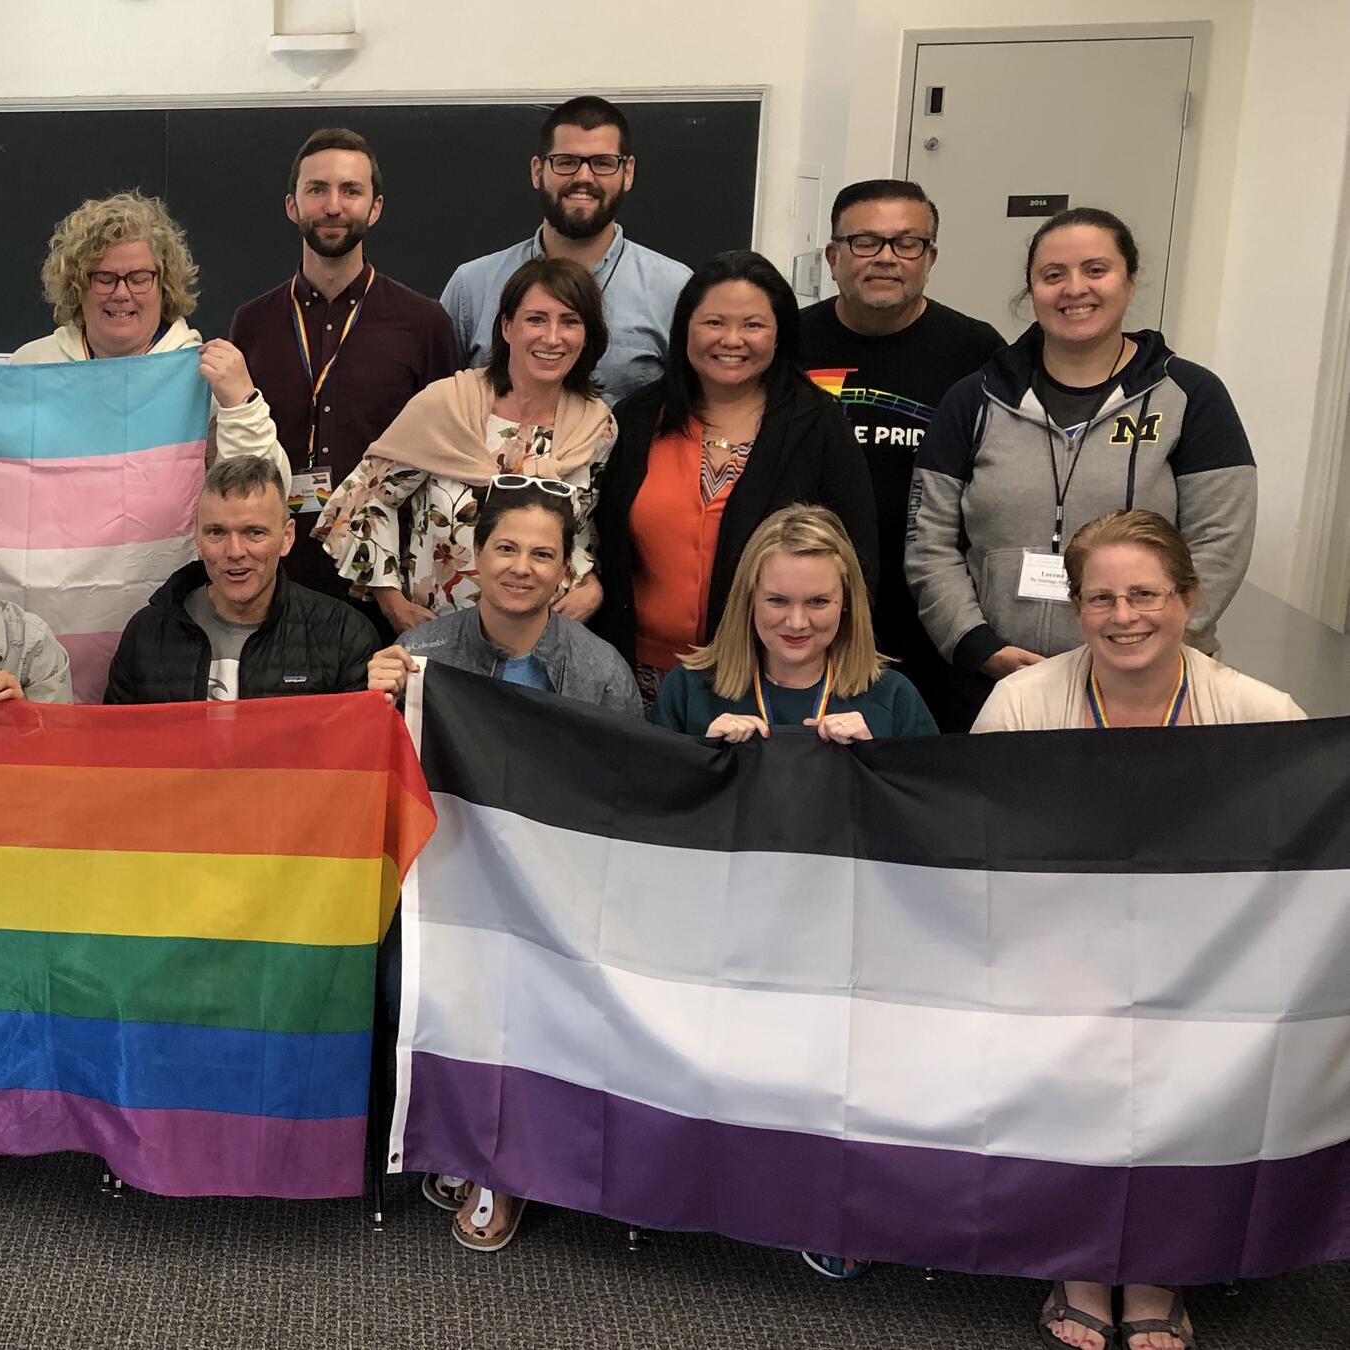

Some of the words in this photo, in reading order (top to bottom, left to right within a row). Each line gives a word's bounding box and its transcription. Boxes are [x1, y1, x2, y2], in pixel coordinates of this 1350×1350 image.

[854, 425, 869, 444] E
[874, 426, 926, 446] PRID
[1109, 413, 1162, 444] M
